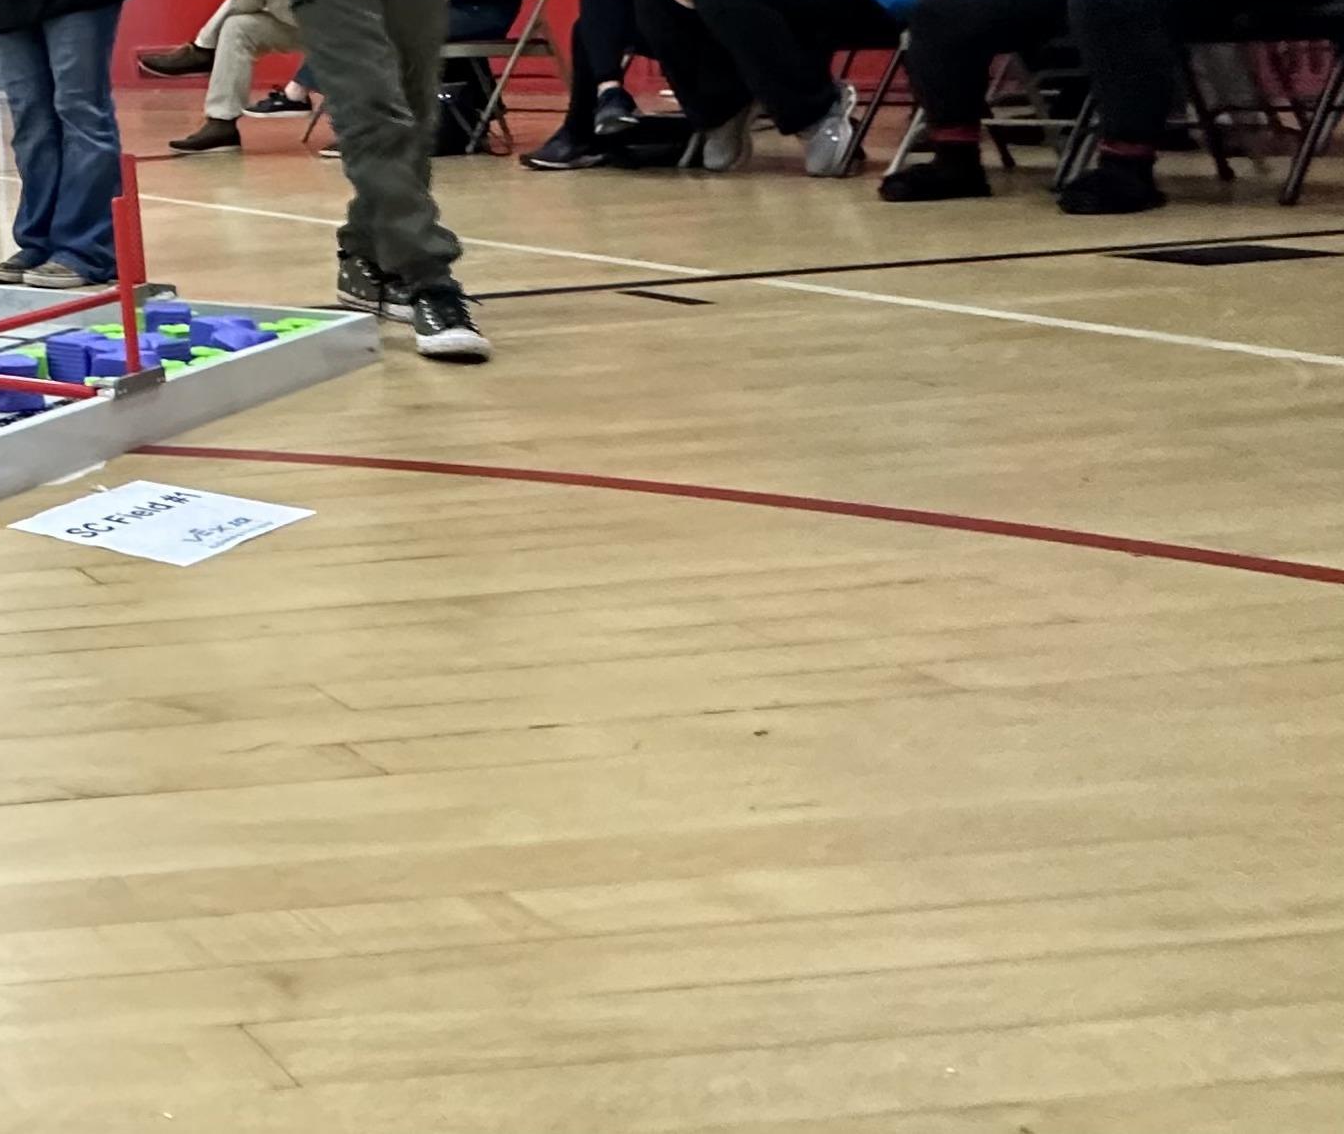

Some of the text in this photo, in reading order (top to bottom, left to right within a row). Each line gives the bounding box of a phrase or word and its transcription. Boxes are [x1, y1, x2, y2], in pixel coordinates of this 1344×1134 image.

[65, 491, 203, 539] SC Field #1
[181, 524, 235, 543] VEX
